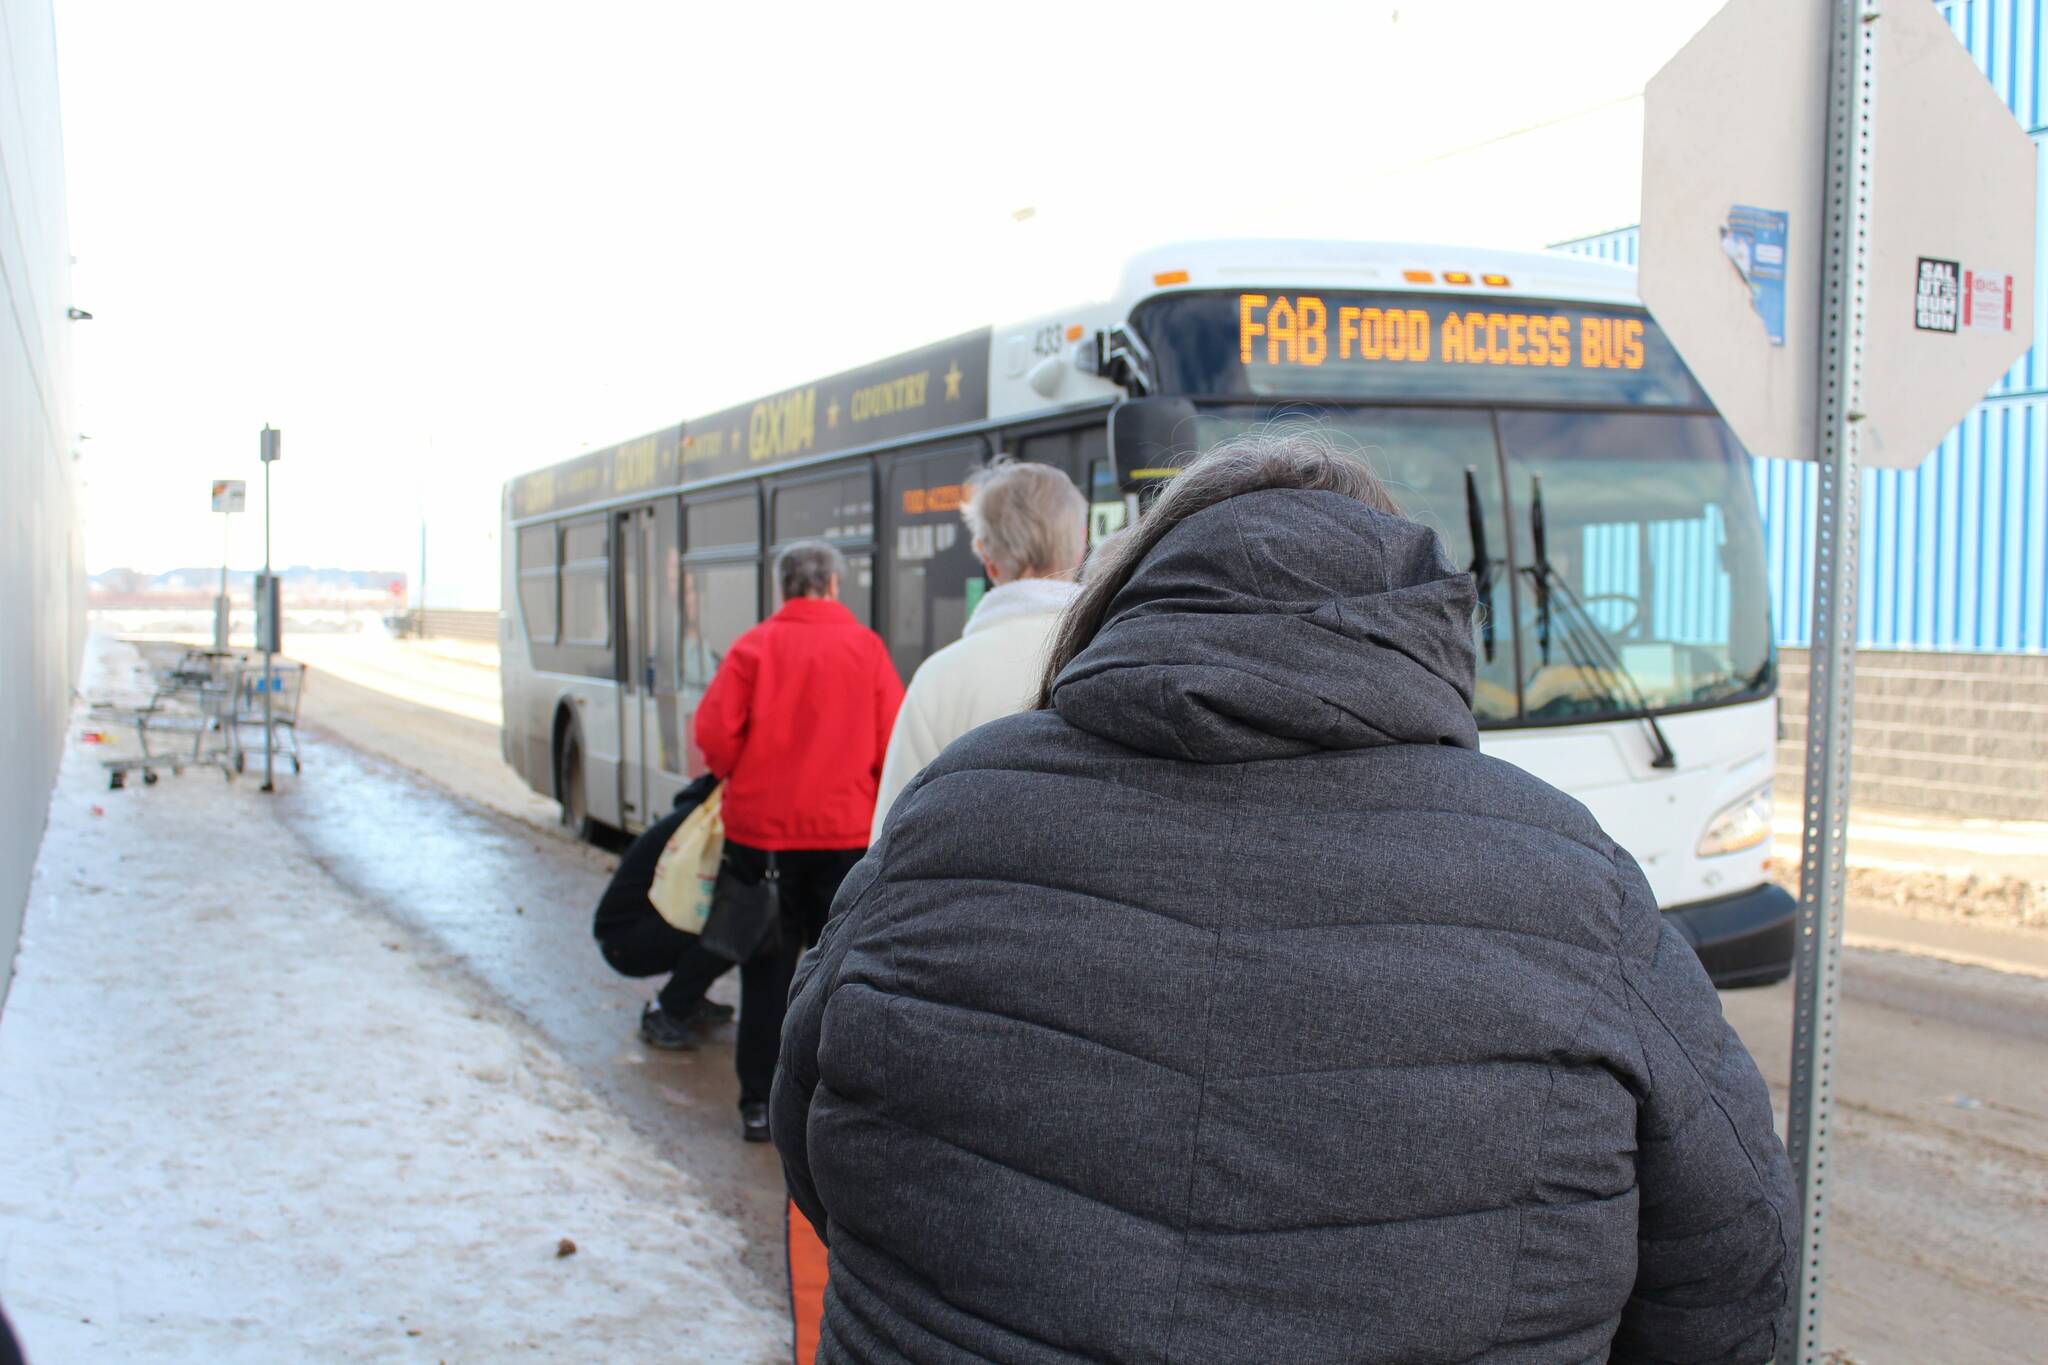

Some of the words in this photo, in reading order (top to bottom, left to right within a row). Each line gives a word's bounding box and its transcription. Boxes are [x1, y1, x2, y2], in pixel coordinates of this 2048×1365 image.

[1239, 293, 1328, 366] FAB
[1338, 306, 1430, 362] FOOD
[1441, 311, 1571, 367] ACCESS
[1581, 317, 1645, 370] BUS
[850, 370, 929, 423] COUNTRY
